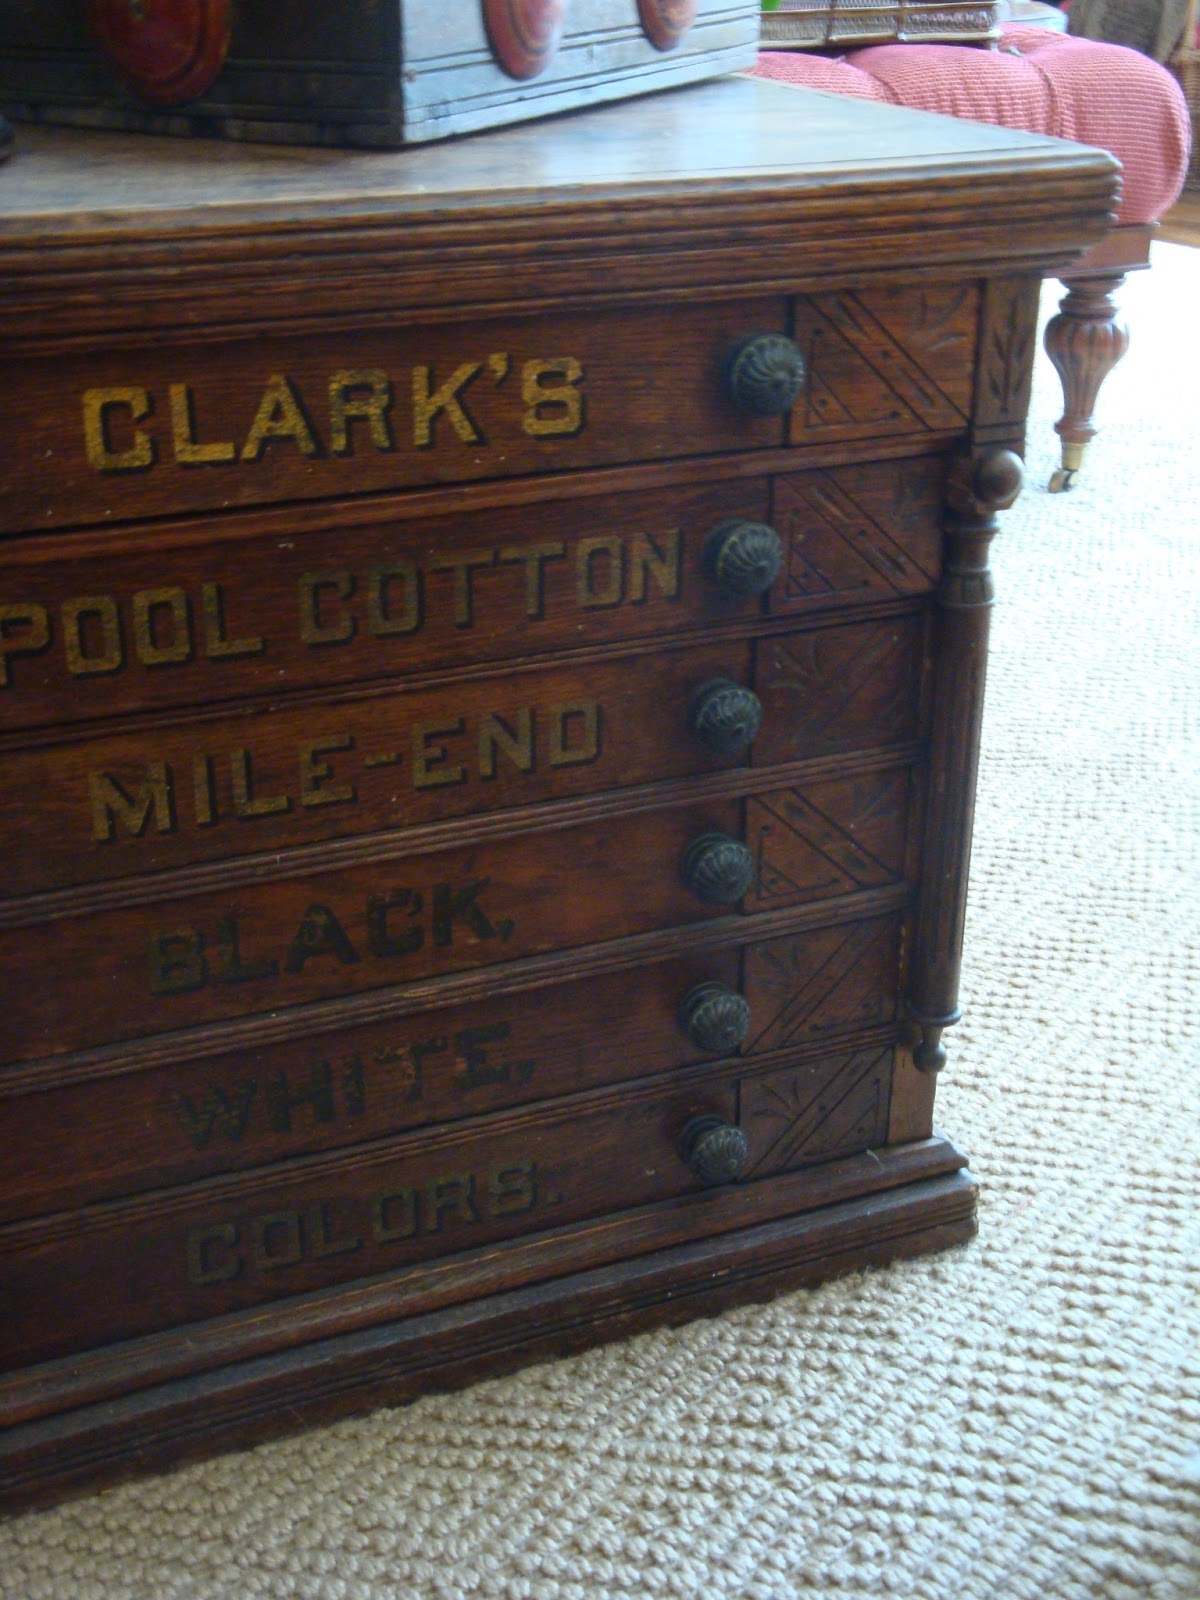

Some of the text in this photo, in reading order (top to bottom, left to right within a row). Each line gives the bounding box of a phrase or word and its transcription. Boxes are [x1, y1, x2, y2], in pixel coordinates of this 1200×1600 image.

[82, 352, 586, 473] CLARK'S
[298, 525, 683, 646] COTTON
[88, 701, 602, 843] MILE-END
